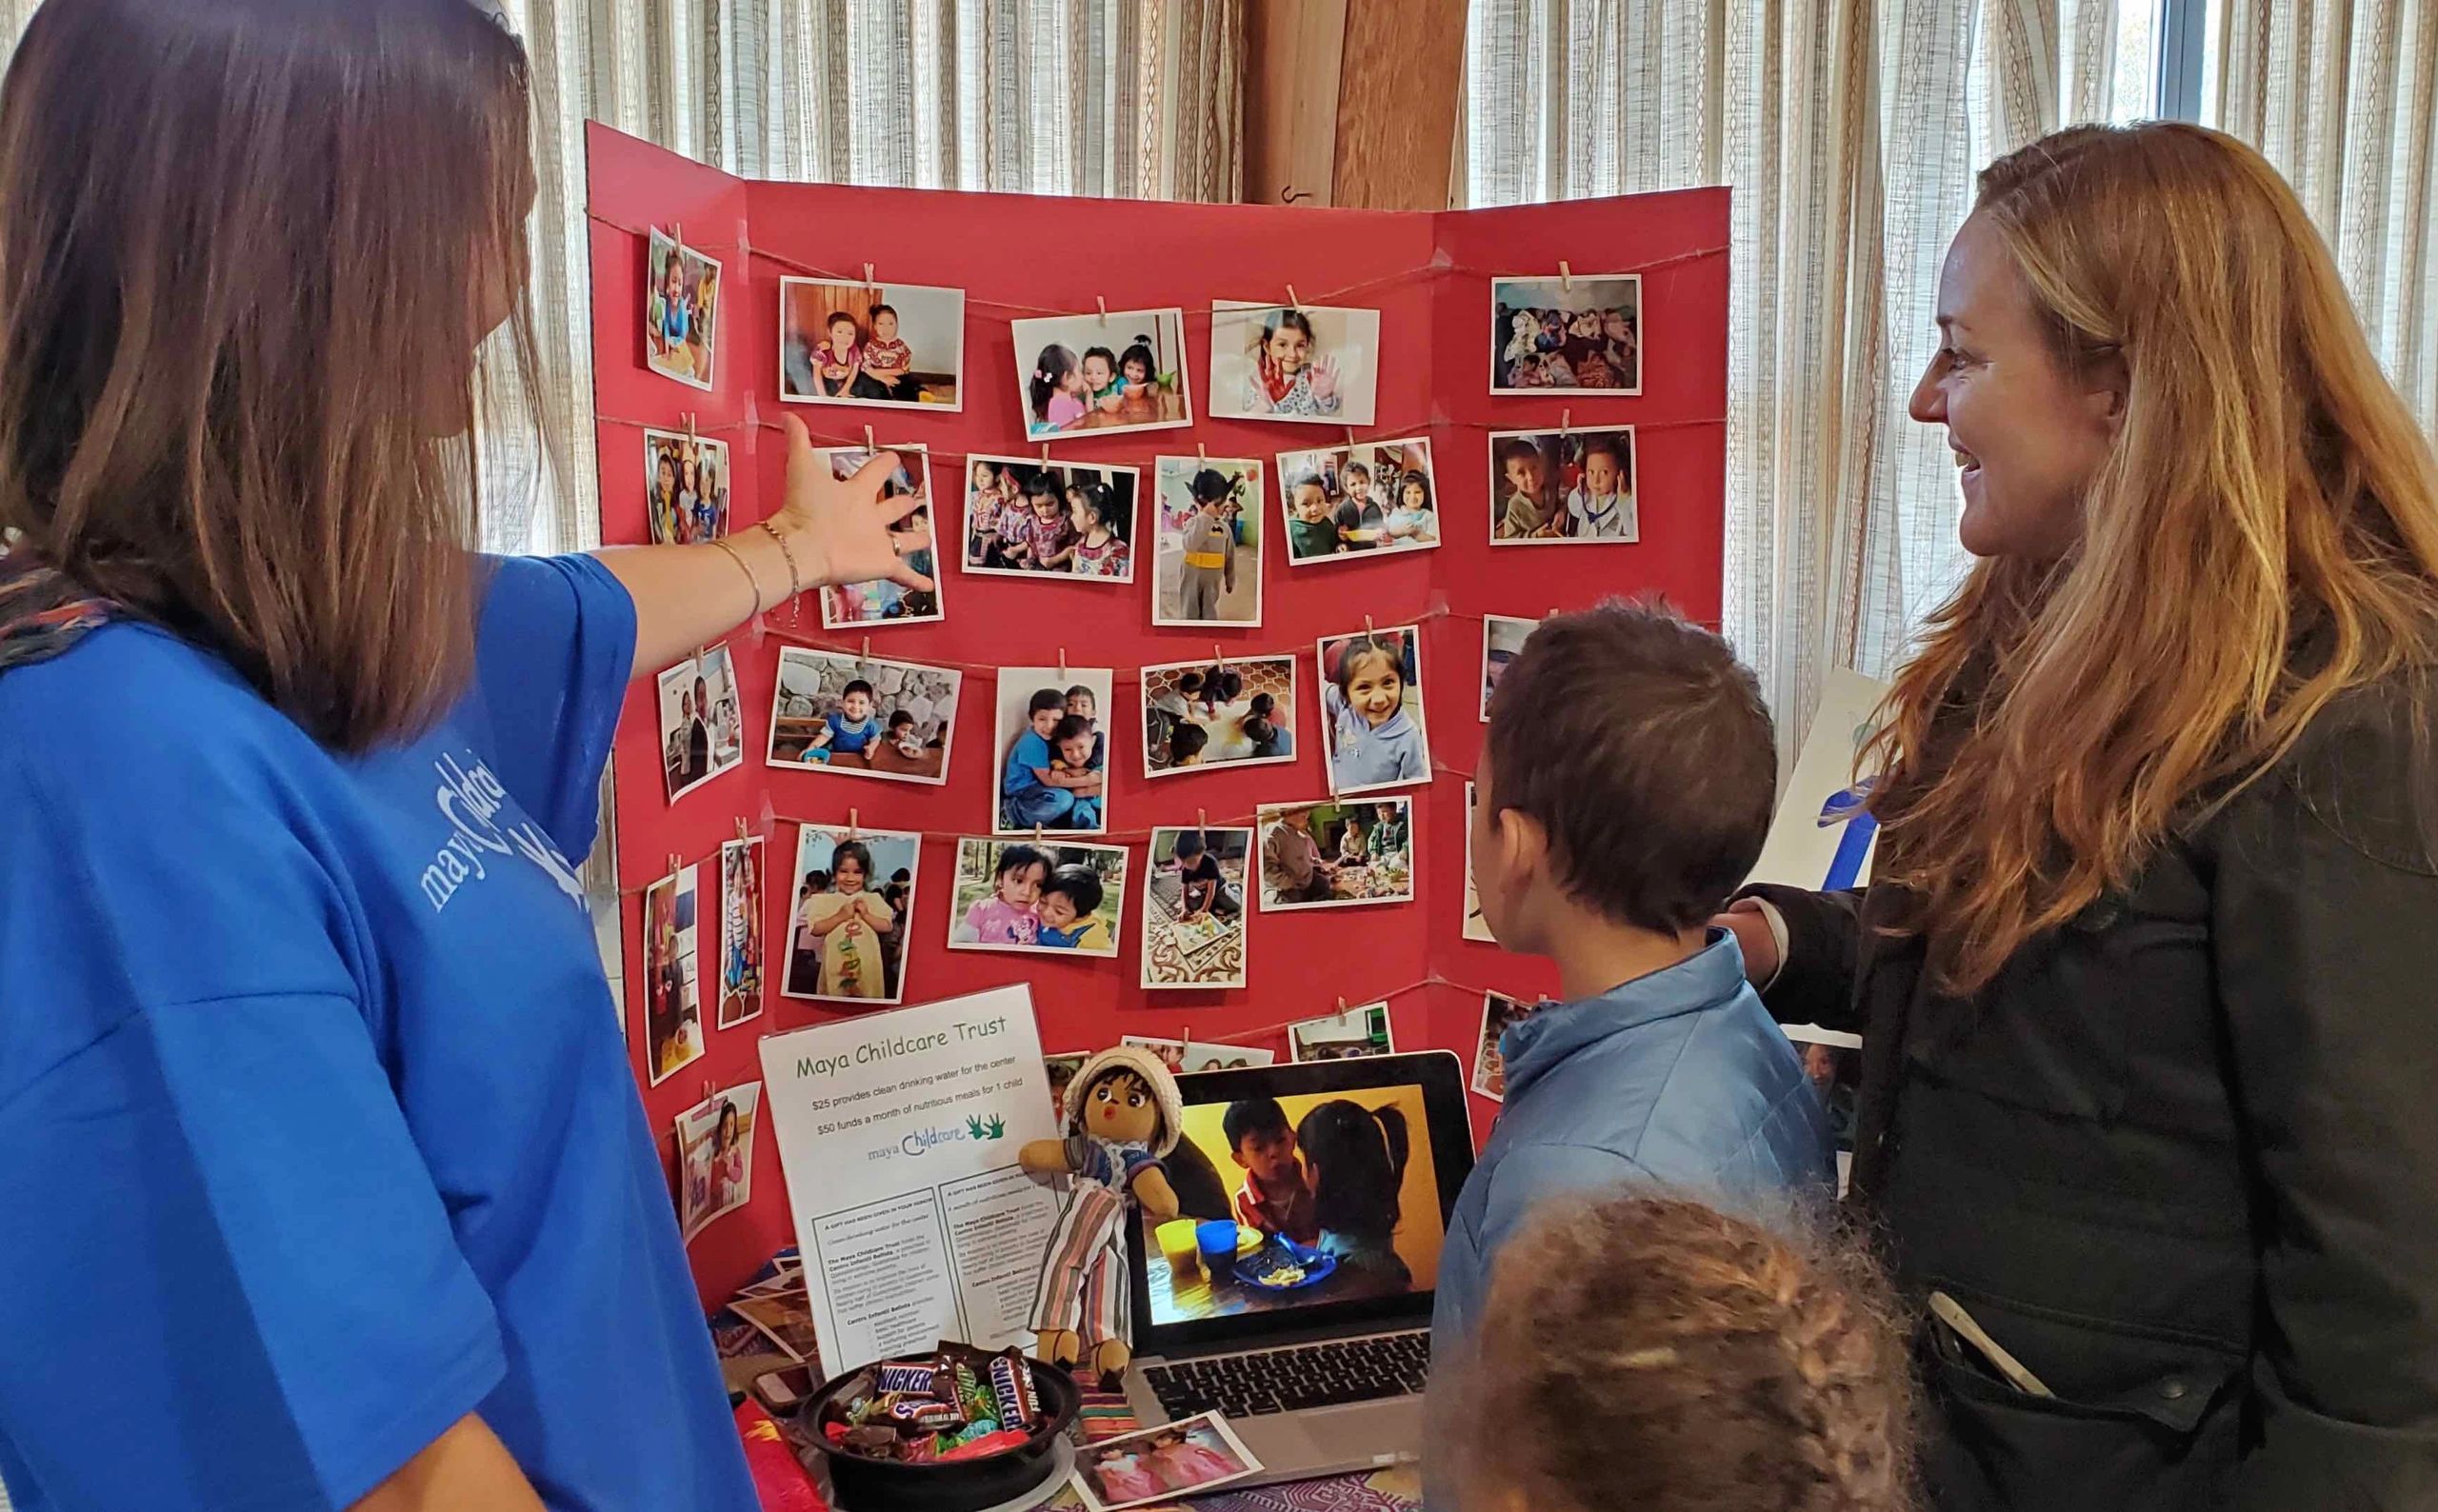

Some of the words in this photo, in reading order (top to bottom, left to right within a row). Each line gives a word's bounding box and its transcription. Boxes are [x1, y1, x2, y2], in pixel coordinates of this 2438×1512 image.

[797, 1056, 850, 1079] Maya
[855, 1032, 949, 1064] Childcare
[952, 1015, 1007, 1041] Trust
[812, 1098, 830, 1111] $25
[832, 1090, 871, 1108] provides
[873, 1084, 897, 1097] clean
[899, 1076, 934, 1091] drinking
[935, 1069, 959, 1082] water
[961, 1065, 972, 1075] for
[974, 1063, 989, 1072] the
[989, 1056, 1016, 1068] center
[817, 1123, 835, 1135] $50
[837, 1117, 863, 1130] funds
[872, 1107, 901, 1122] month
[903, 1104, 911, 1114] of
[913, 1096, 953, 1112] nutritious
[955, 1088, 981, 1101] meals
[982, 1084, 994, 1094] for
[1003, 1077, 1024, 1090] child
[868, 1144, 900, 1161] maya
[902, 1125, 966, 1156] Childcare
[879, 1367, 933, 1392] NICKER
[991, 1358, 1023, 1432] SNICKER
